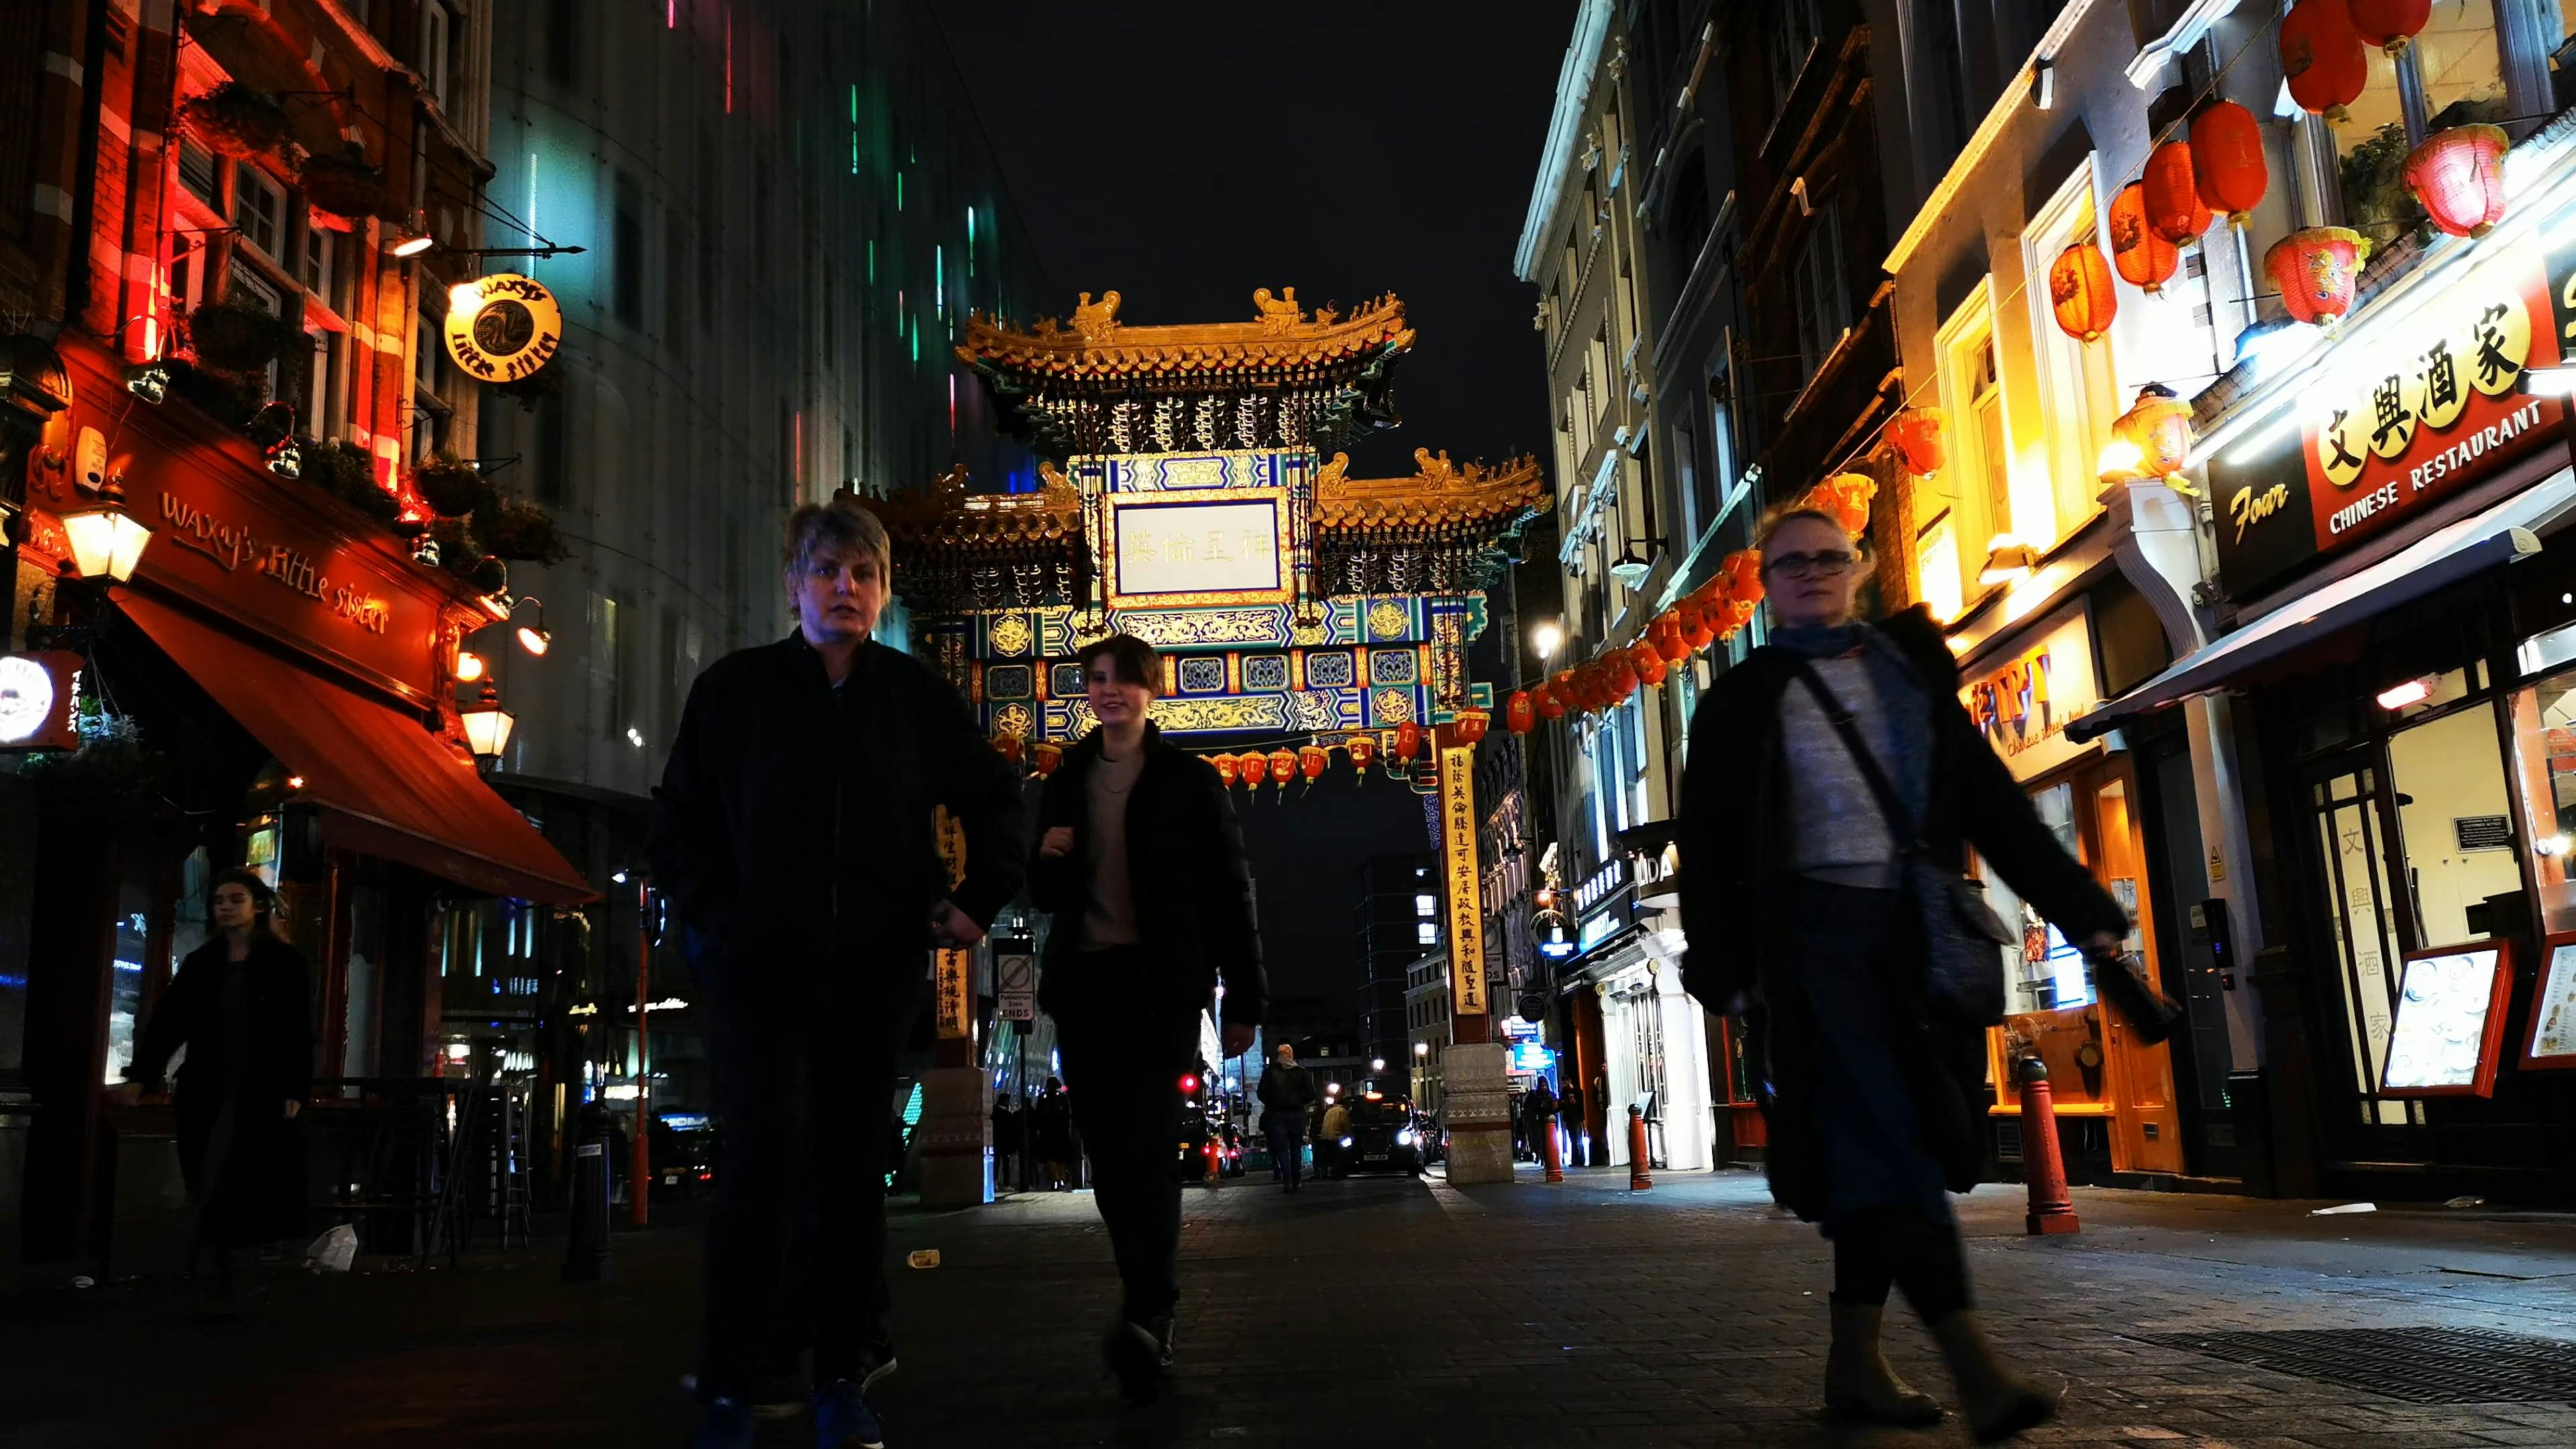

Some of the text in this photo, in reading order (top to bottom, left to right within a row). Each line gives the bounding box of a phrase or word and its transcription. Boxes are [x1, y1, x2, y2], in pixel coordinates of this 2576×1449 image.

[2328, 303, 2519, 471] 文興酒家
[2230, 483, 2289, 545] Four
[2329, 400, 2541, 535] CHINESE RESTAURANT
[1988, 643, 2051, 724] TPT
[2343, 828, 2390, 1040] 文興酒家
[1002, 1009, 1030, 1018] ENDS
